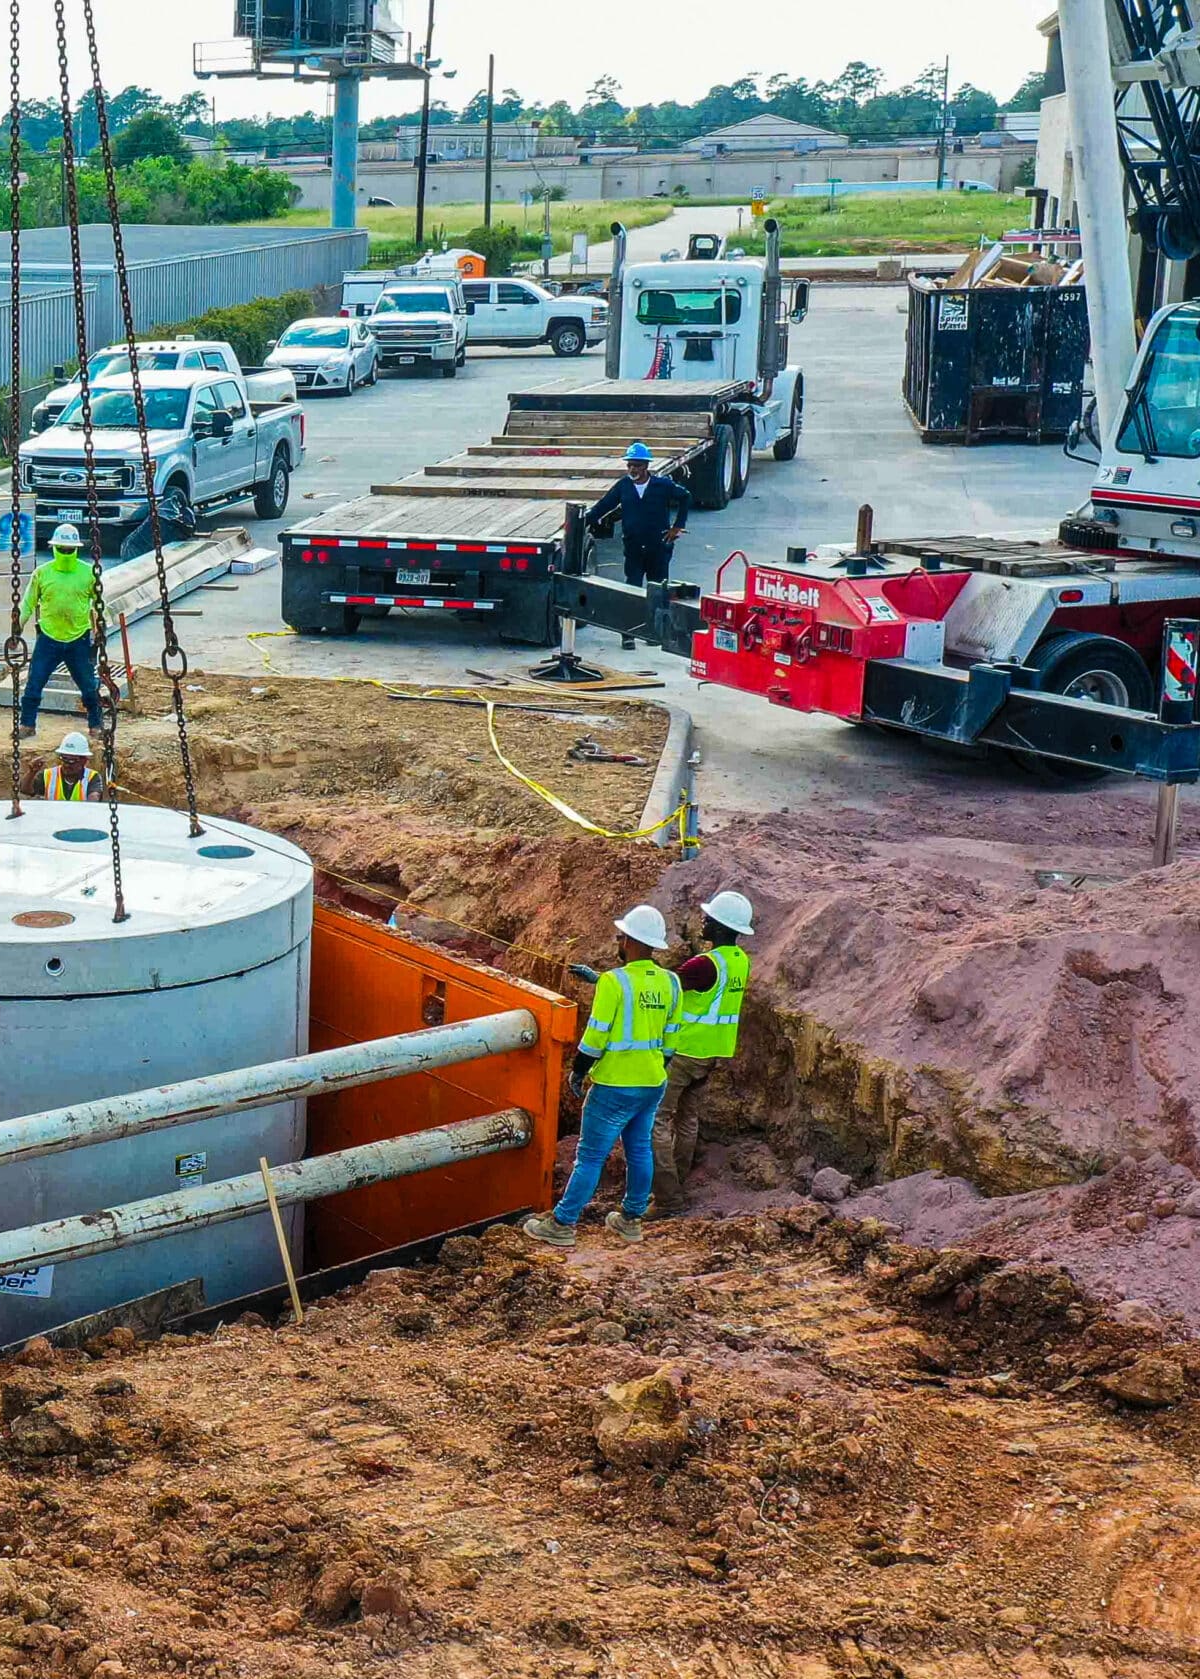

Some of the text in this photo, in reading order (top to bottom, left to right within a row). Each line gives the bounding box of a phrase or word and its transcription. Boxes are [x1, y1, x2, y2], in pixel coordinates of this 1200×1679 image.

[1058, 292, 1081, 302] 4597
[940, 315, 967, 323] Sprint
[755, 577, 819, 608] Link-Belt
